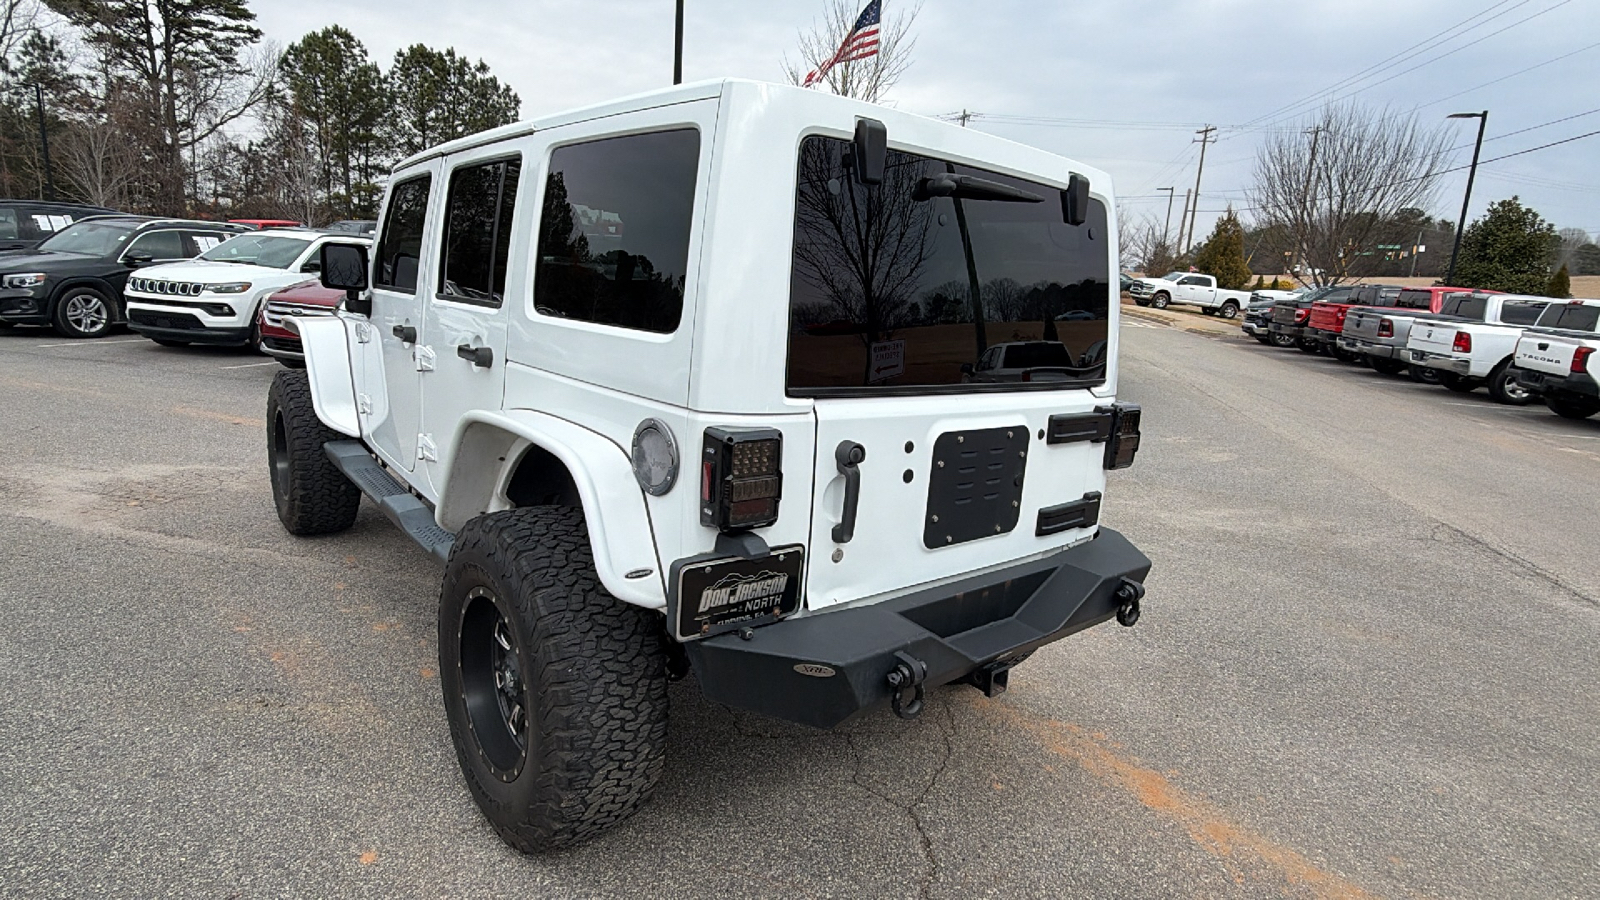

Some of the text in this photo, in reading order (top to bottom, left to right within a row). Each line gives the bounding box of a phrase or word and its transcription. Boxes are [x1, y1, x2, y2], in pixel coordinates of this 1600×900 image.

[1522, 353, 1561, 364] TACOMA
[698, 576, 788, 613] DON JACKSON
[745, 595, 782, 613] NORTH
